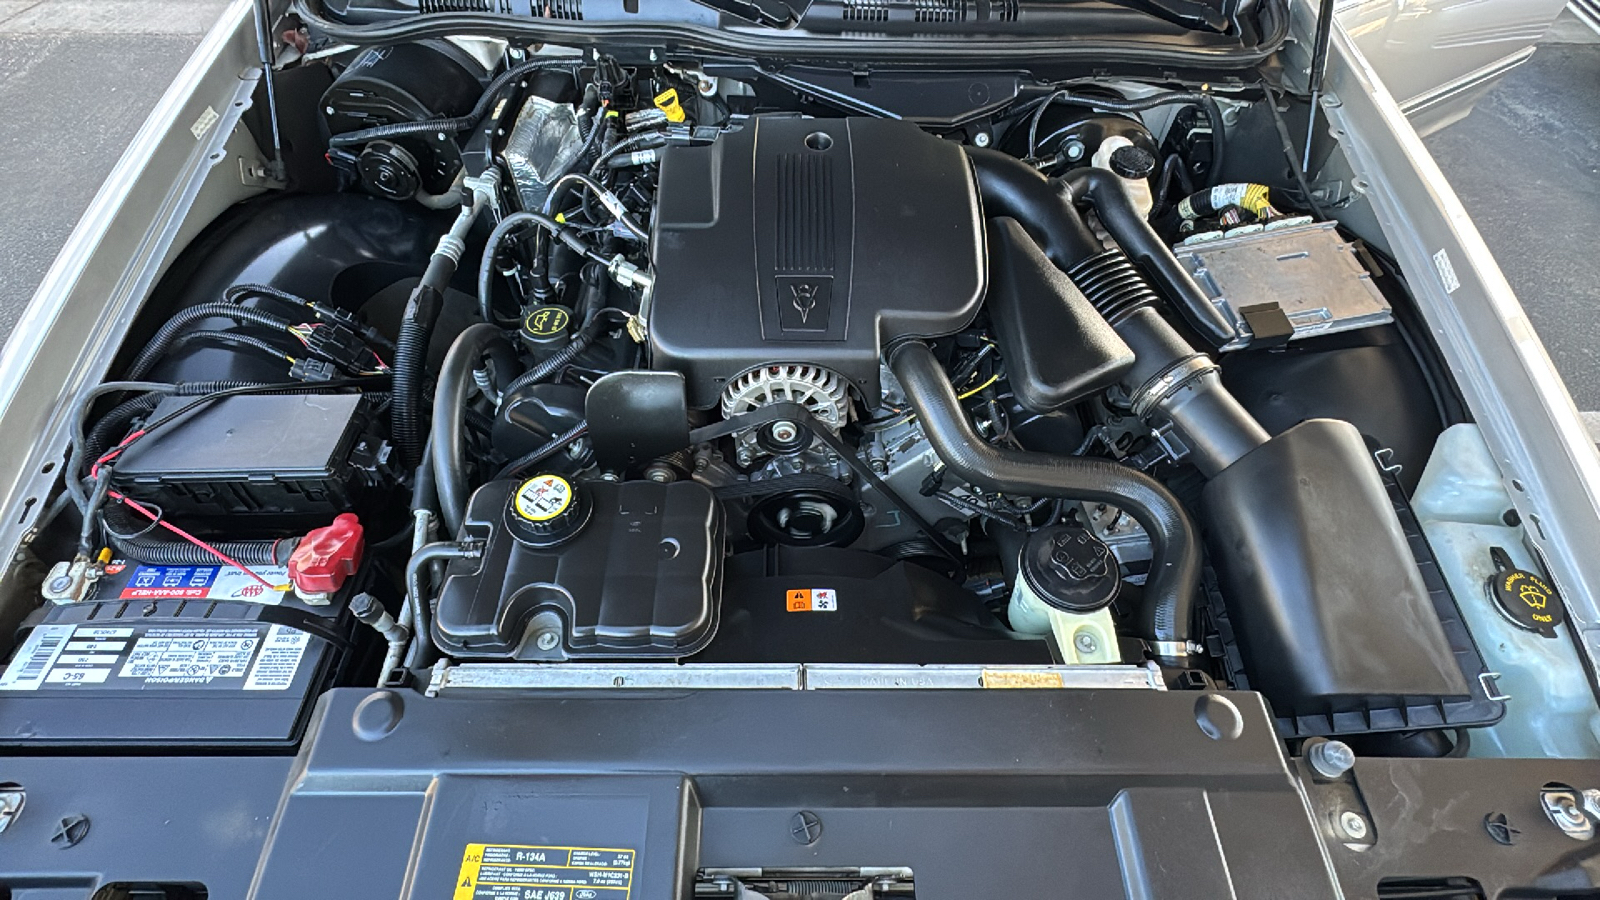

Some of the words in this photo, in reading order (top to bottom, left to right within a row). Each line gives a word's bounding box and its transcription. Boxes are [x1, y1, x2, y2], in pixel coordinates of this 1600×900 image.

[1505, 572, 1526, 592] WASHER
[1529, 576, 1553, 595] FLUID
[242, 585, 263, 598] AAA
[1532, 613, 1553, 623] ONLY
[63, 672, 86, 681] 65-C
[144, 676, 206, 684] DANGER/POISON
[911, 677, 934, 686] USA
[465, 854, 481, 863] A/C
[516, 851, 546, 863] R-134A
[524, 890, 543, 900] SAE
